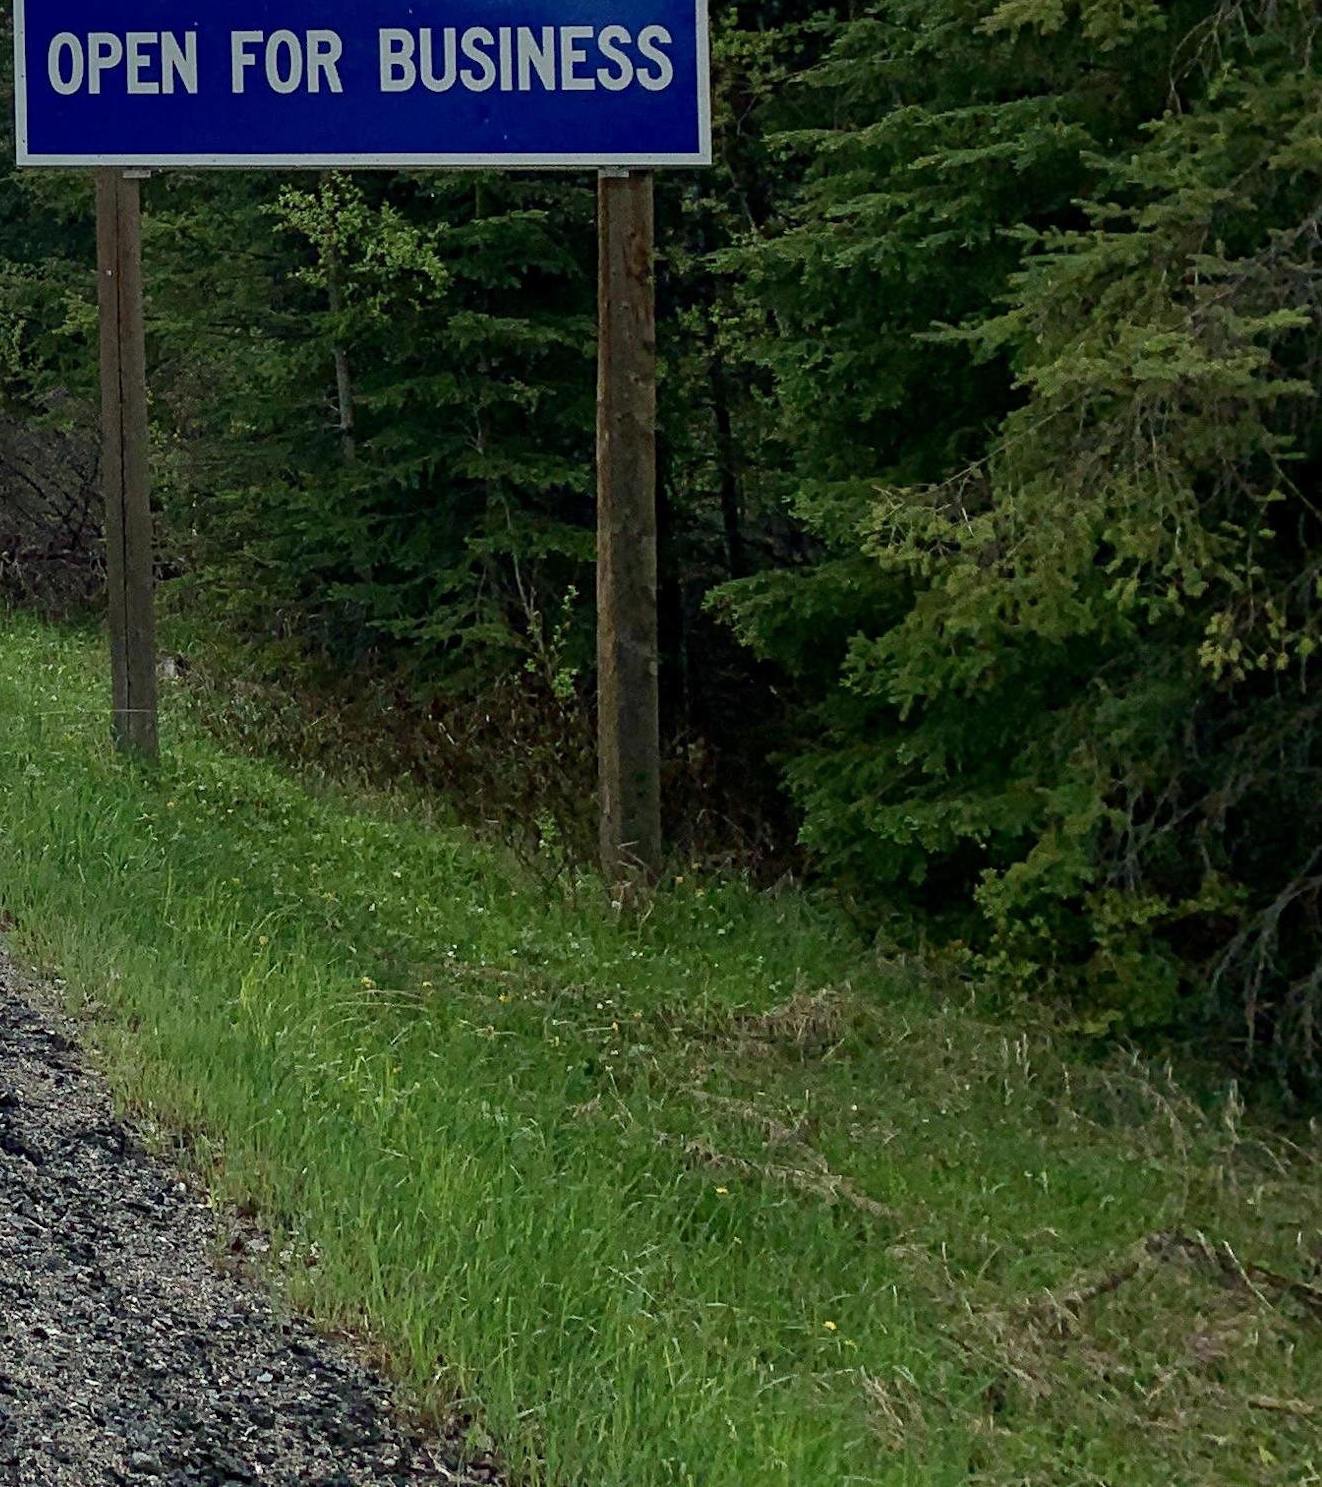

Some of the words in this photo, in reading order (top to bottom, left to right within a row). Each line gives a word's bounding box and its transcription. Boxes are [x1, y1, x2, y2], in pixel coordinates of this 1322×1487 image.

[47, 31, 198, 95] OPEN
[231, 29, 343, 94] FOR
[379, 24, 674, 93] BUSINESS
